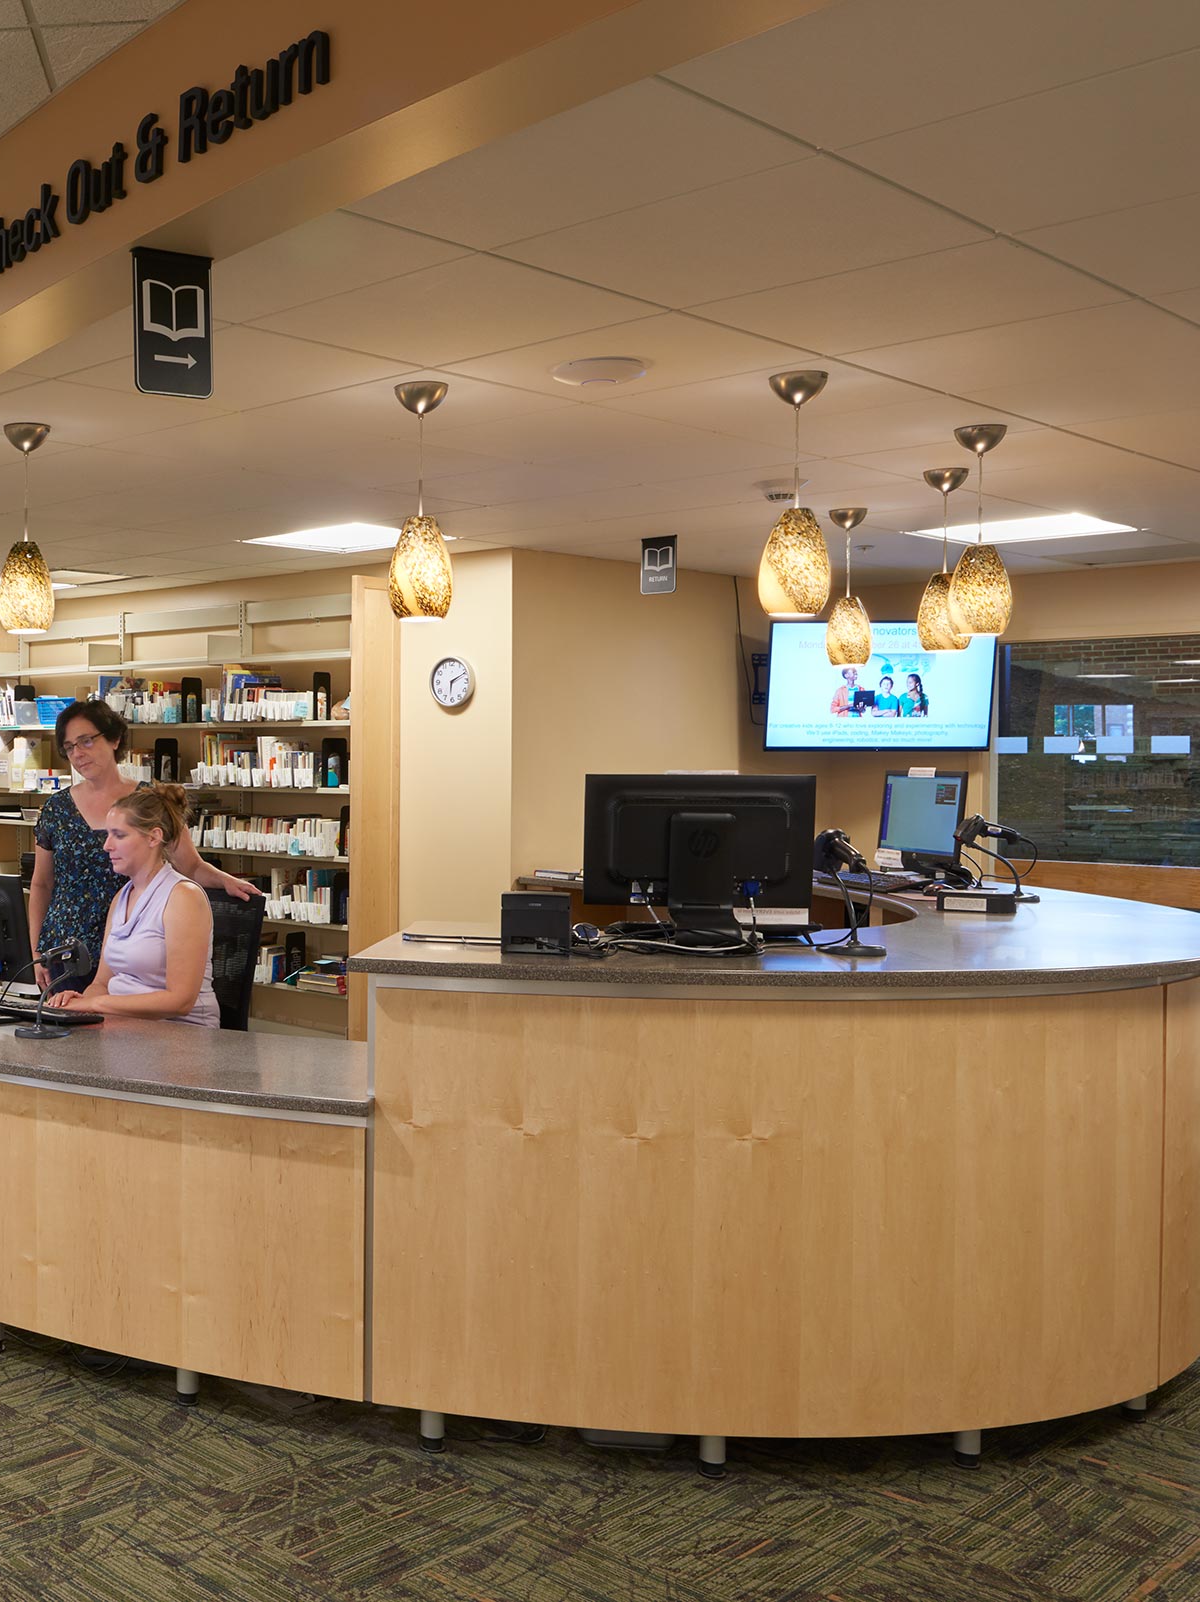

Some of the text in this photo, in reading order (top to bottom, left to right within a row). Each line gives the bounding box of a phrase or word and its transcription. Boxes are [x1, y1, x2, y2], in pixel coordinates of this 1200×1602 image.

[66, 142, 128, 225] Out
[135, 112, 168, 184] &
[178, 30, 330, 164] Return
[872, 627, 917, 636] novators
[798, 641, 826, 650] Mond
